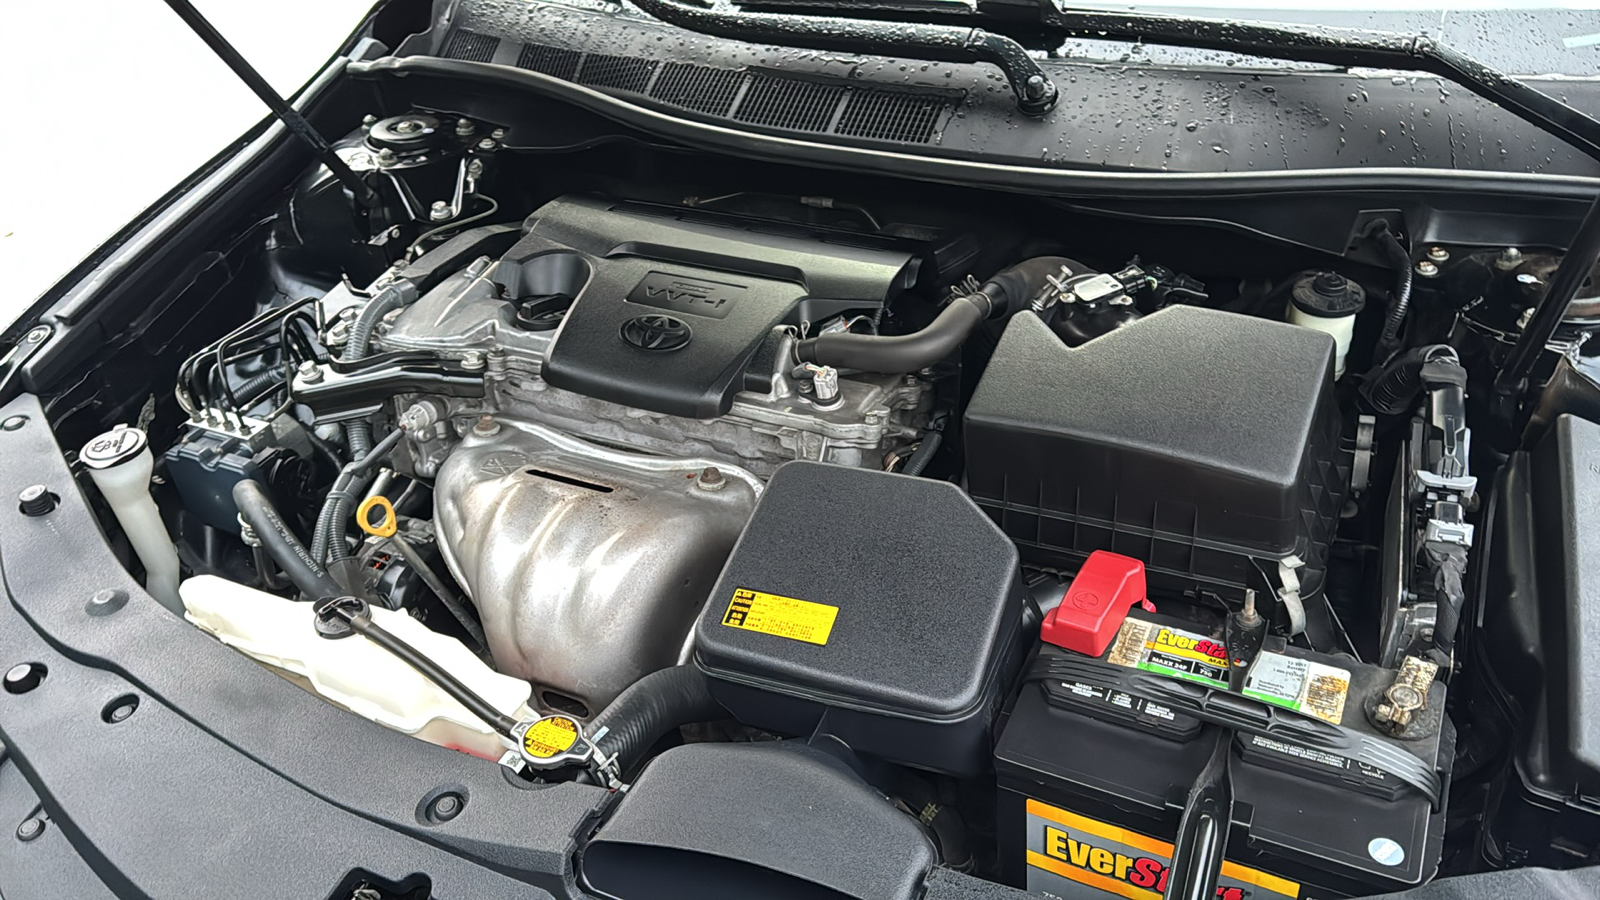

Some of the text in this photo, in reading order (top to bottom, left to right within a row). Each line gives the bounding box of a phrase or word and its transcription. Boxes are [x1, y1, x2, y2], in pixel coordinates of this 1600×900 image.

[1156, 628, 1227, 659] EverSta
[1151, 656, 1174, 668] MAXX
[1208, 658, 1228, 667] MAX
